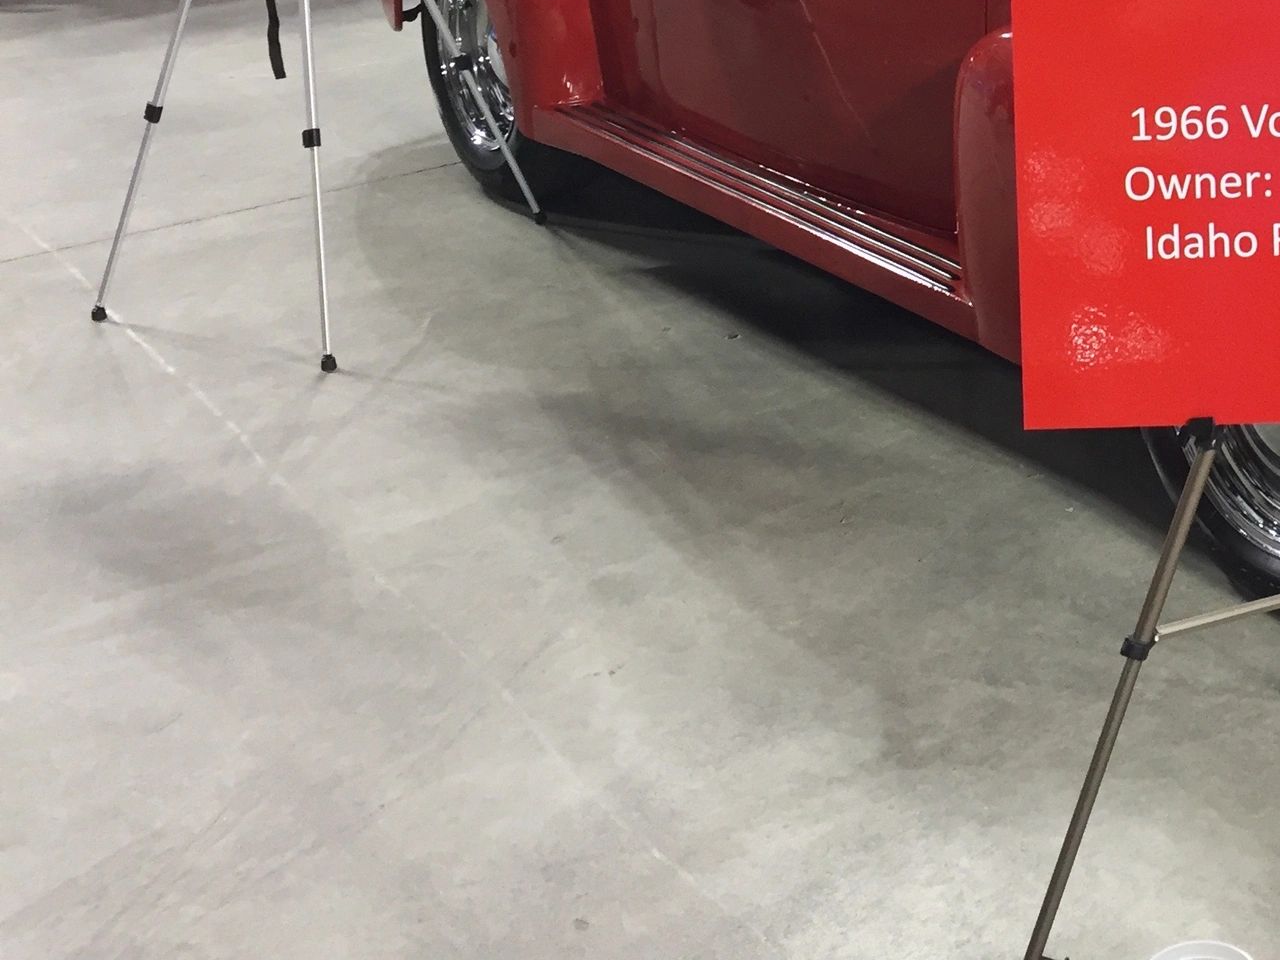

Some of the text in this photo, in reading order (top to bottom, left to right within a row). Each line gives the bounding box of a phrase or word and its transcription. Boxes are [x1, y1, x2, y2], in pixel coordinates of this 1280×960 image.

[1130, 104, 1230, 142] 1966
[1123, 165, 1273, 202] Owner:
[1145, 224, 1259, 261] Idaho
